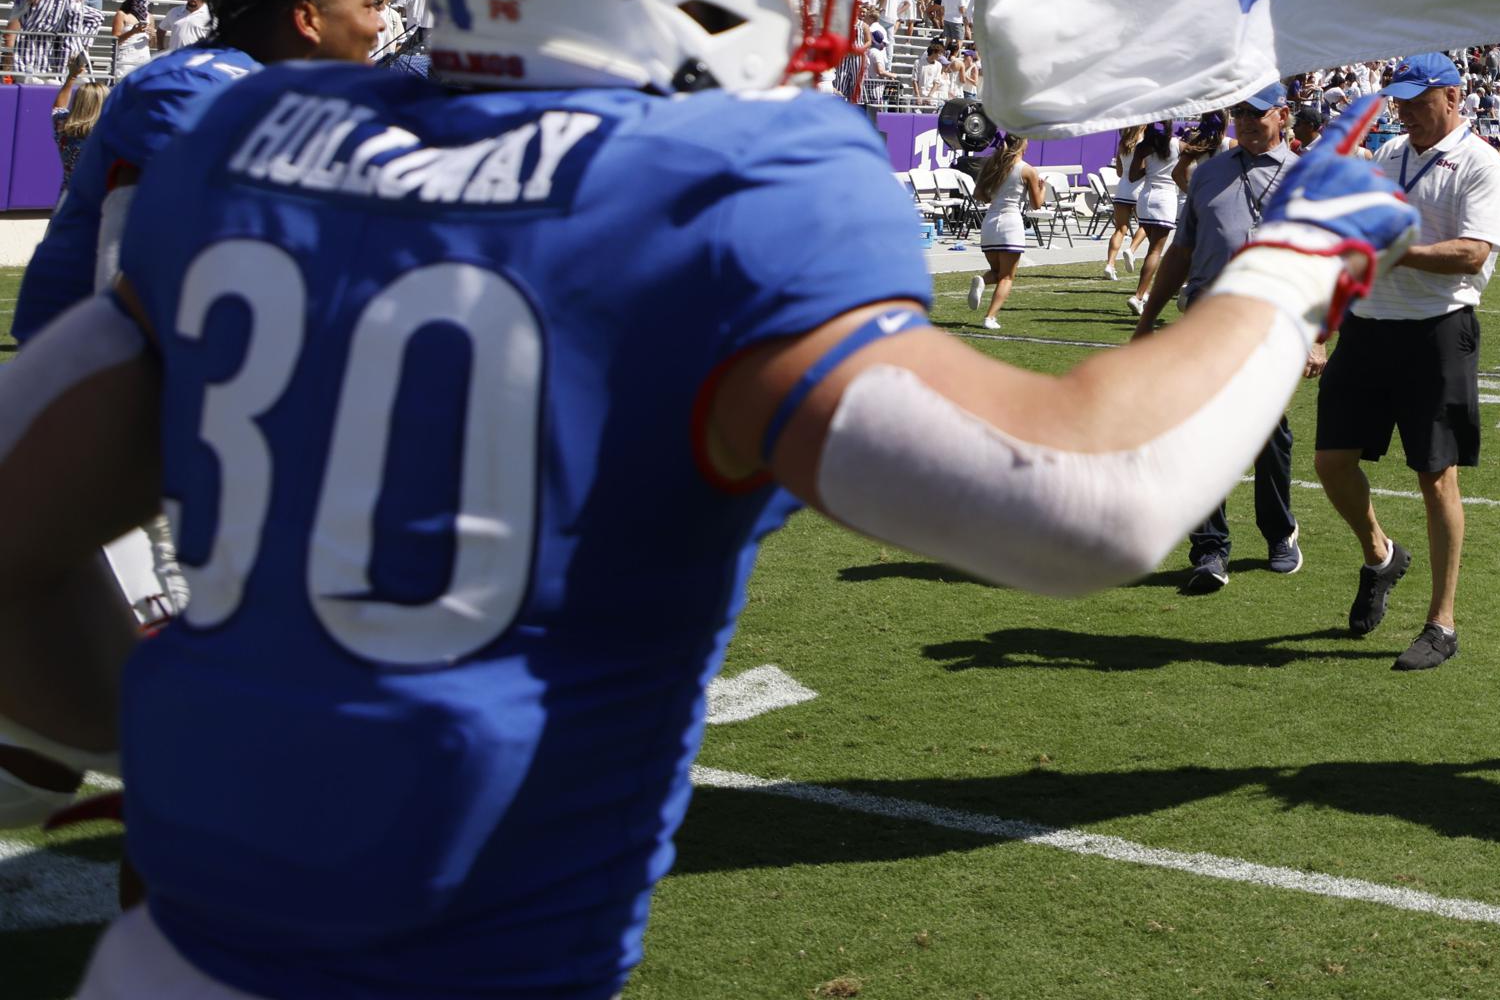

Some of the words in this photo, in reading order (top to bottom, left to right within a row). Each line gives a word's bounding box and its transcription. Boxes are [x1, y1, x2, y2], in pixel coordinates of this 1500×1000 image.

[229, 91, 602, 204] HOLLOWAY
[1436, 158, 1459, 171] SMU
[164, 238, 542, 667] 30
